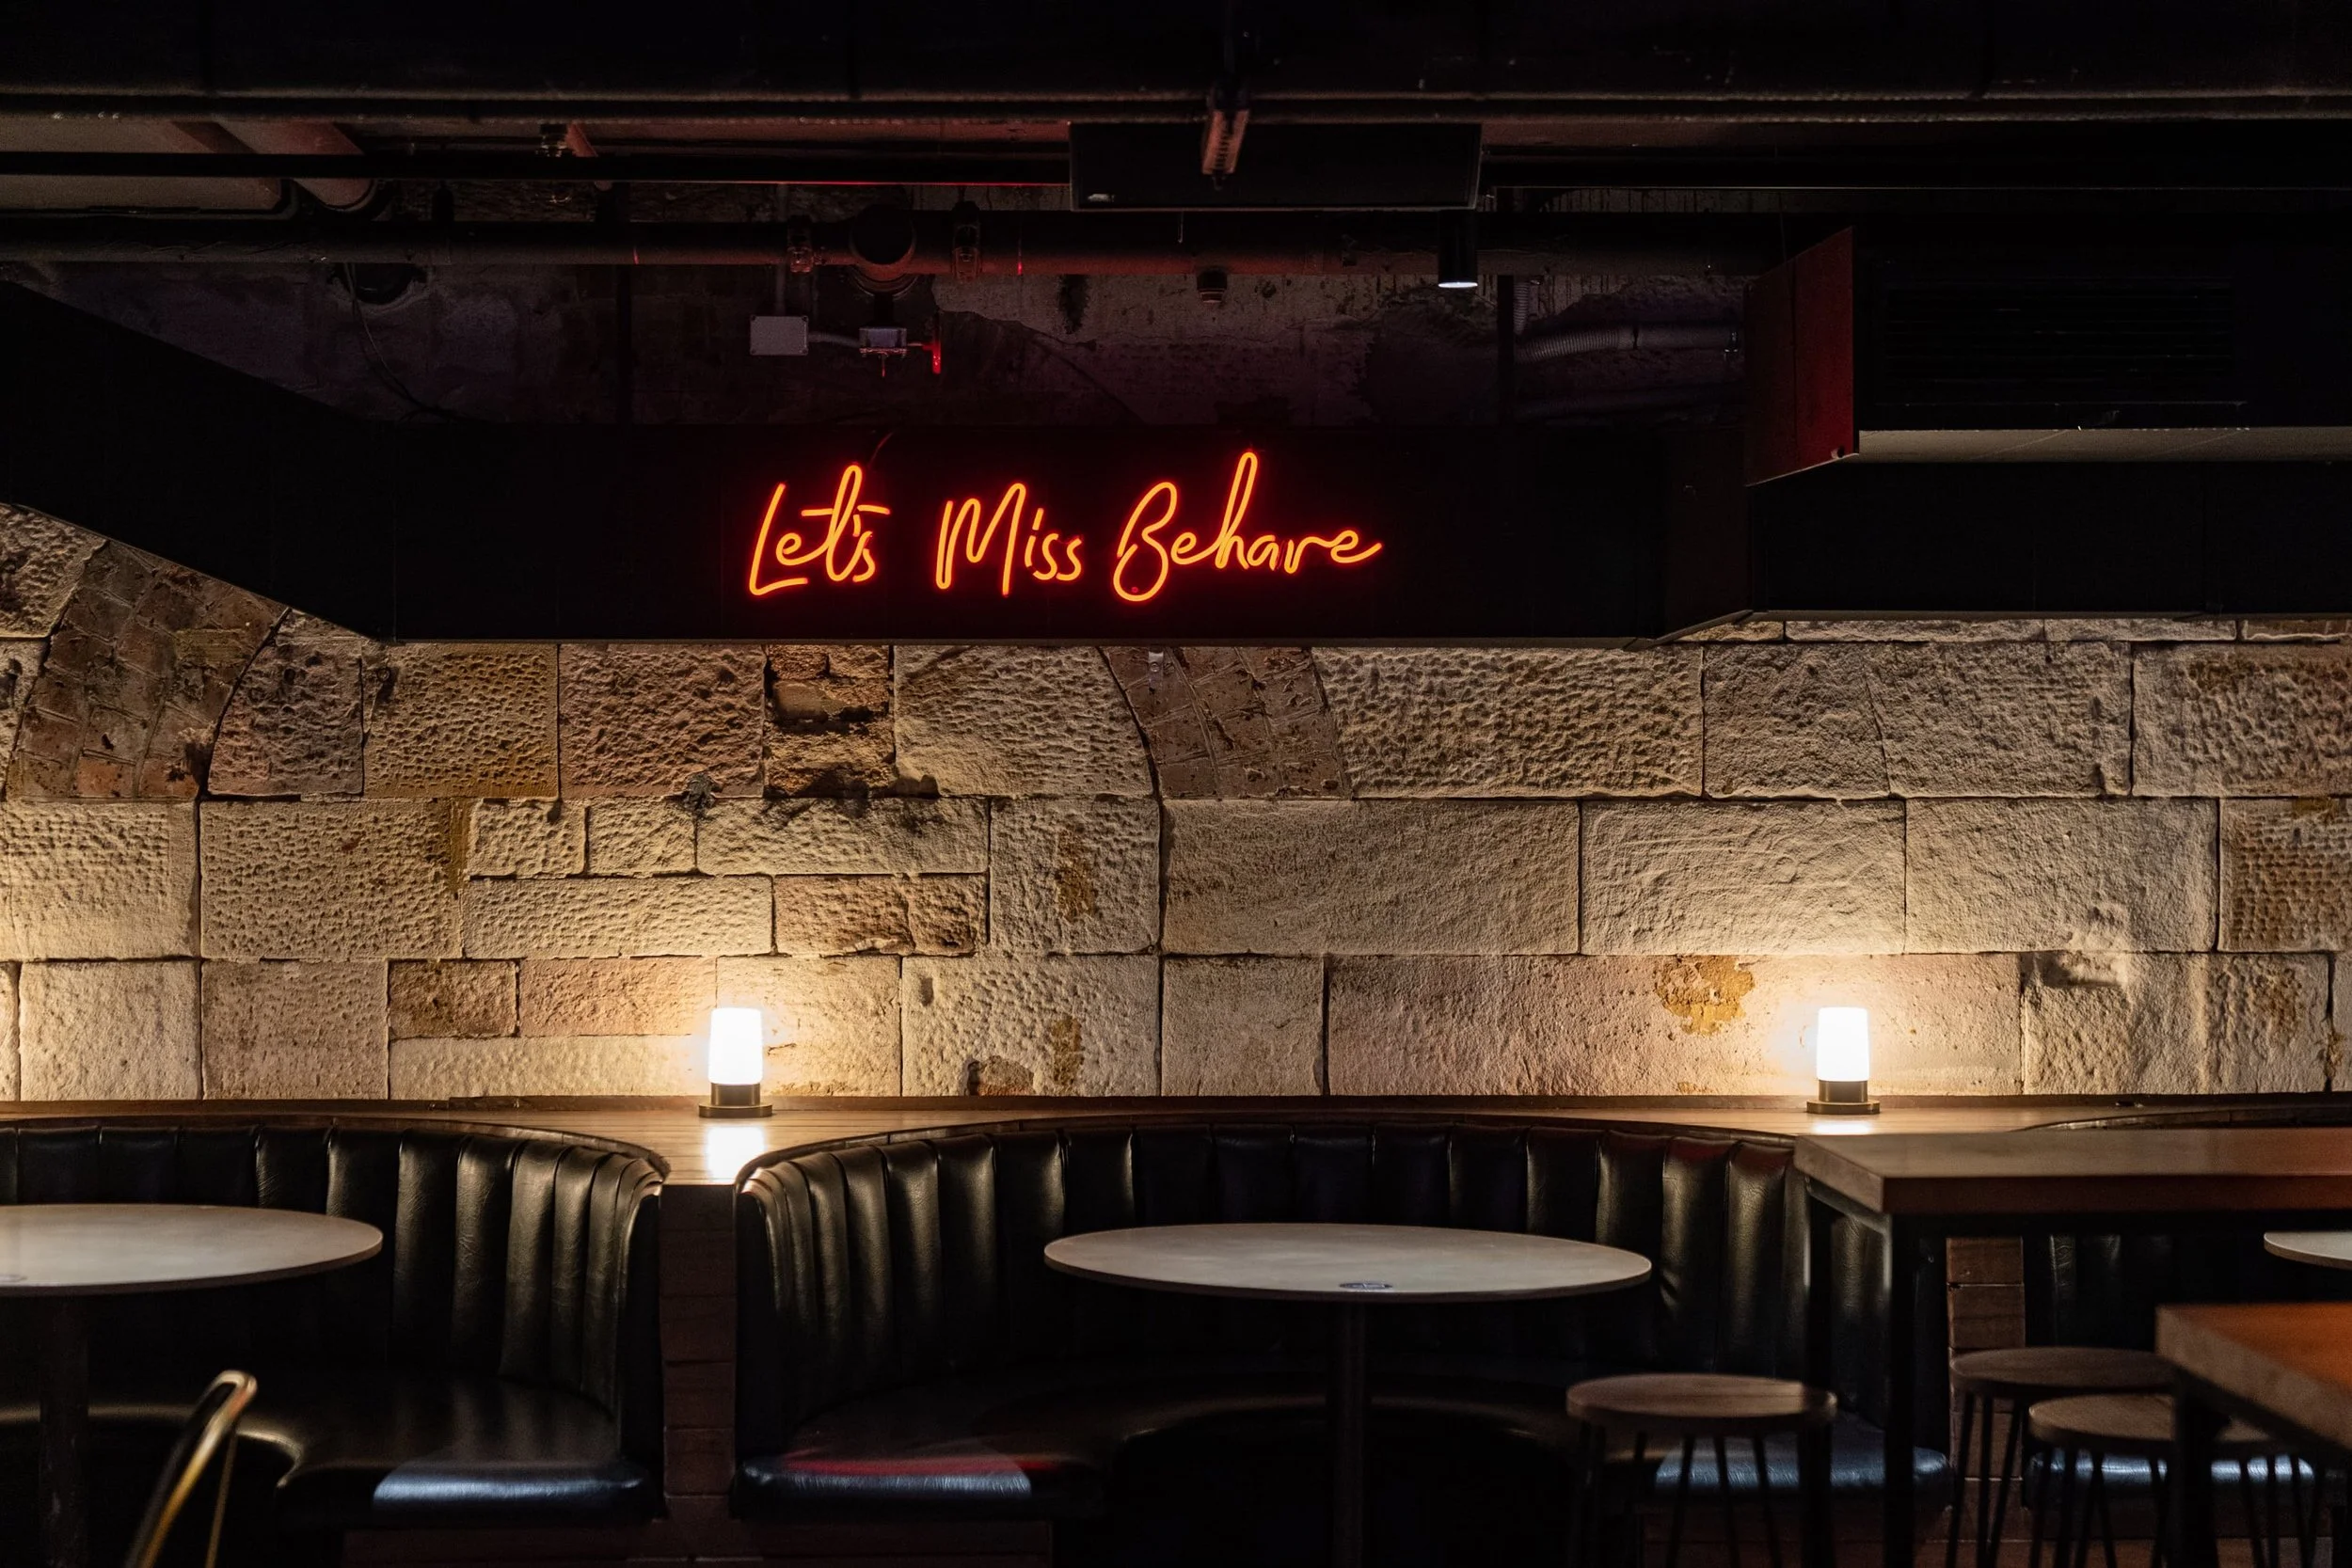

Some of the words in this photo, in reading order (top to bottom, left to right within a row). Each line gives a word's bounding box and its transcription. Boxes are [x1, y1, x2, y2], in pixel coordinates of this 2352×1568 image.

[749, 464, 890, 596] Let's
[935, 483, 1083, 595] Miss
[1113, 451, 1382, 602] Behave
